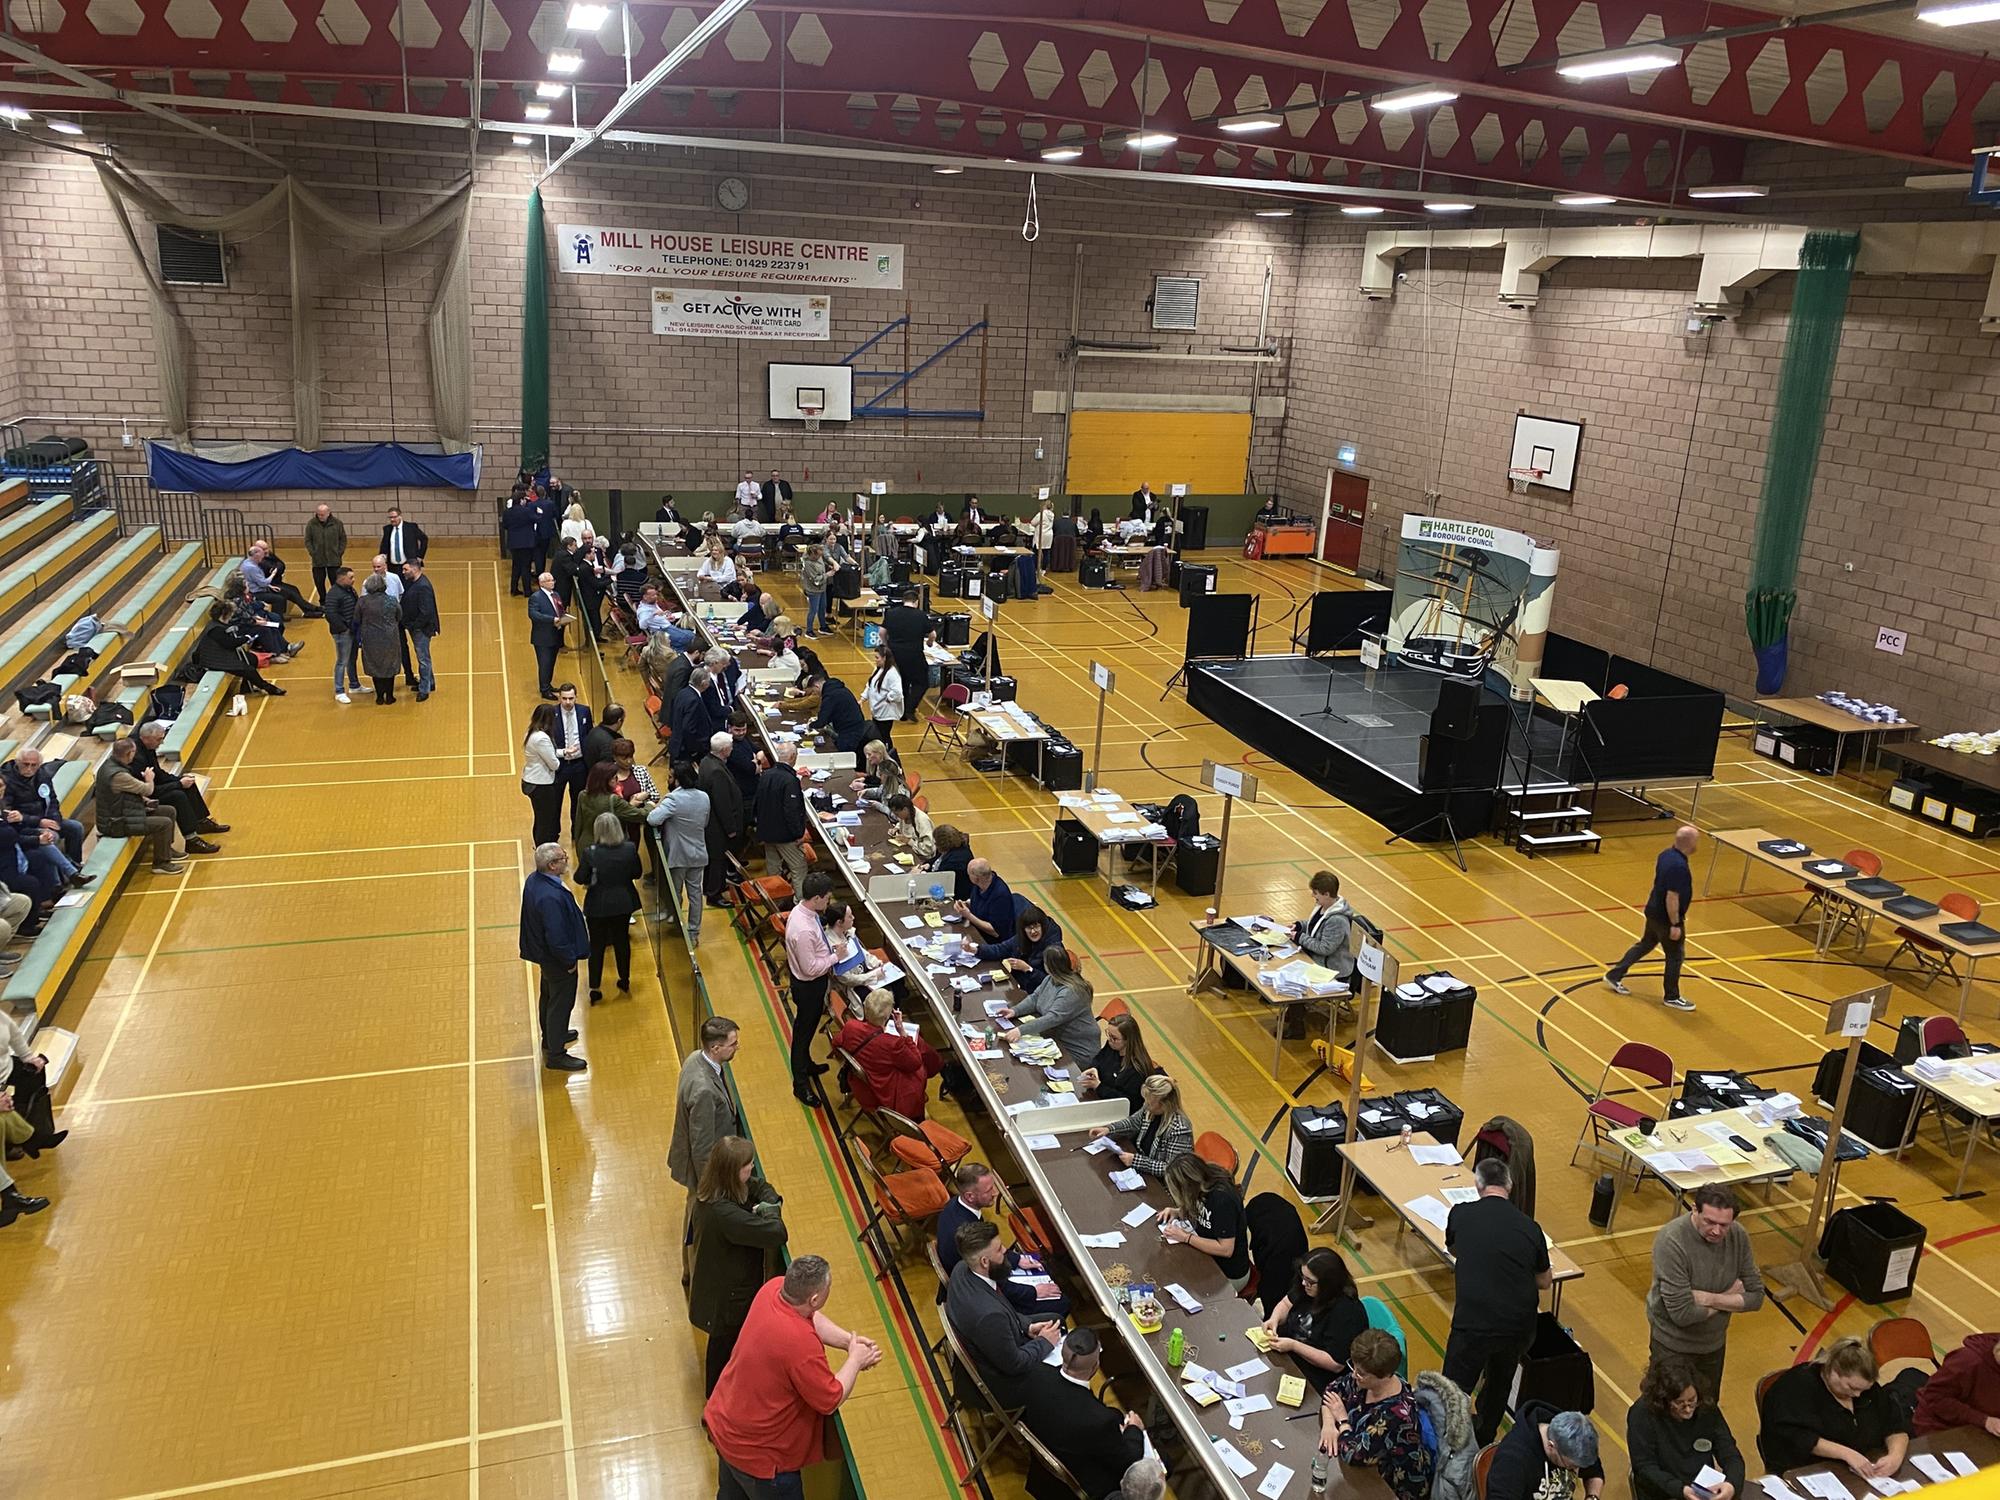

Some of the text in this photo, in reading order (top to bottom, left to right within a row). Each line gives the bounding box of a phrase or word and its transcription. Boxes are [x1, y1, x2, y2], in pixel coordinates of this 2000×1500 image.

[600, 231, 869, 262] MILL HOUSE LEISURE CENTRE
[662, 254, 809, 270] TELEPHONE: 01429 223791
[646, 266, 668, 275] ALL
[672, 267, 708, 277] YOUR
[712, 269, 758, 279] LEISURE
[683, 302, 711, 314] GET
[766, 306, 802, 319] WITH
[761, 319, 783, 327] ACTIVE
[784, 320, 802, 328] CARD
[1434, 521, 1495, 539] HARTLEPOOL
[1432, 532, 1493, 547] BOROUGH COUNCIL
[1879, 633, 1900, 647] PCC
